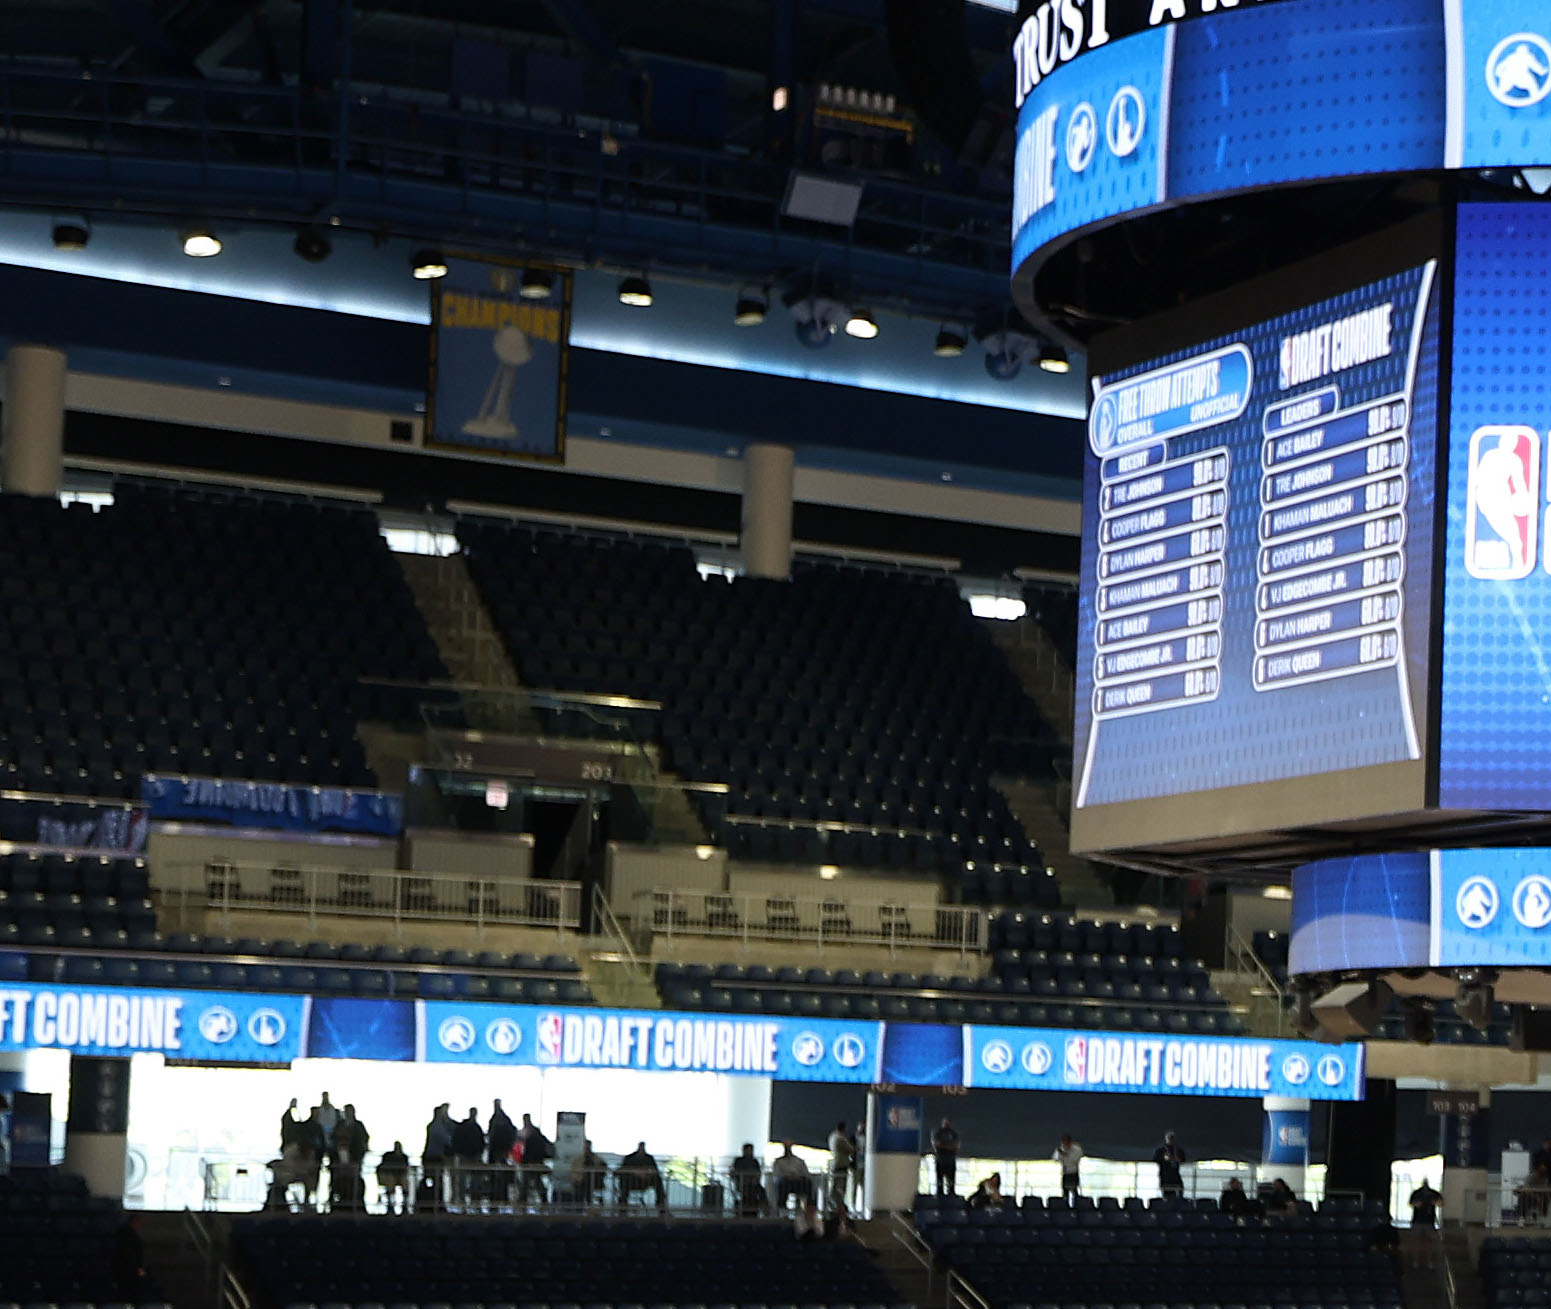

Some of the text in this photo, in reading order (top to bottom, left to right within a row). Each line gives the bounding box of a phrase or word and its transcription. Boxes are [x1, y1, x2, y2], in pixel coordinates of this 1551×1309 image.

[1291, 327, 1331, 386] DRAFT
[1117, 421, 1153, 445] OVERALL
[1280, 399, 1322, 426] LEADERS
[33, 991, 182, 1050] COMBINE
[562, 1013, 779, 1072] DRAFT COMBINE
[1087, 1038, 1270, 1091] DRAFT COMBINE
